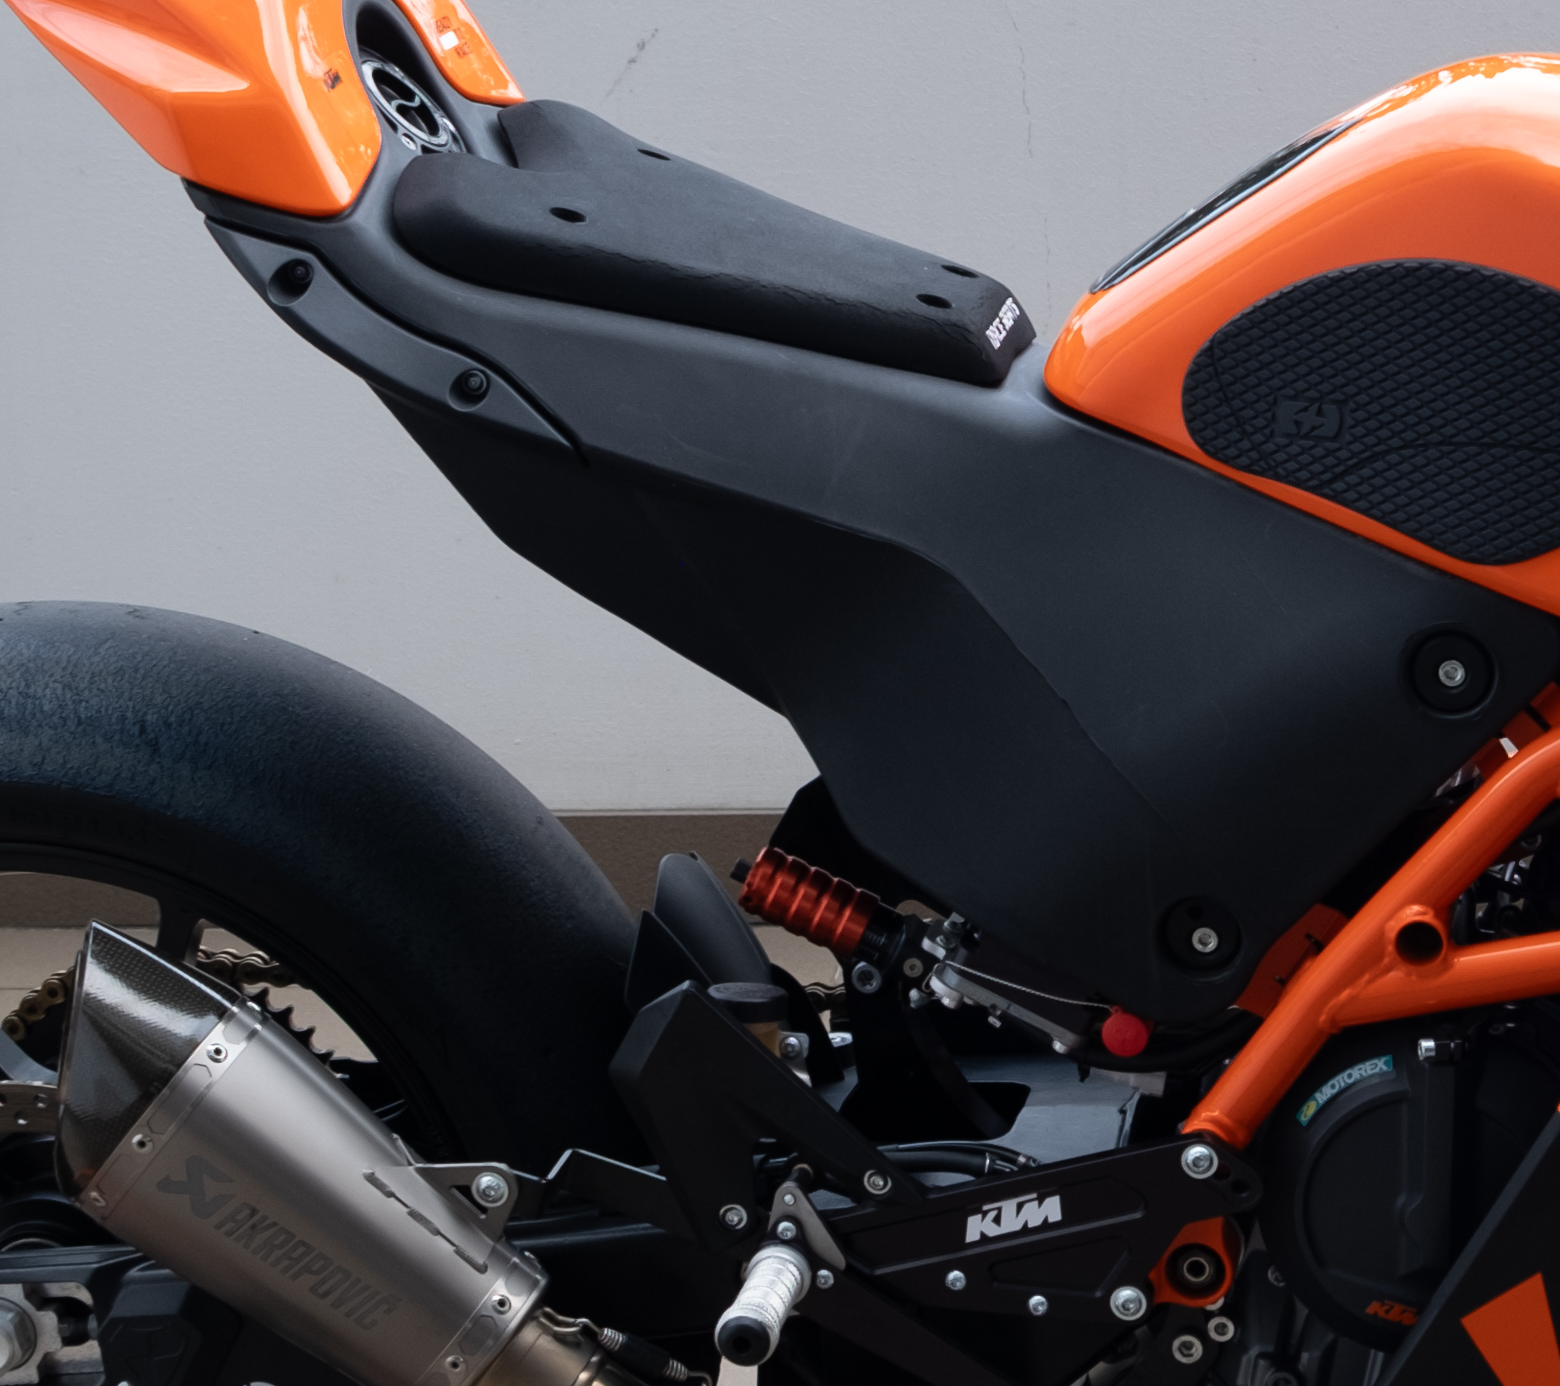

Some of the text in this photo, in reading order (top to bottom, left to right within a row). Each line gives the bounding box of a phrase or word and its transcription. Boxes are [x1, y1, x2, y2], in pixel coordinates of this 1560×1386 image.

[1314, 1055, 1389, 1105] MOTOREX
[965, 1192, 1063, 1244] KTM
[1365, 1299, 1419, 1328] KTM
